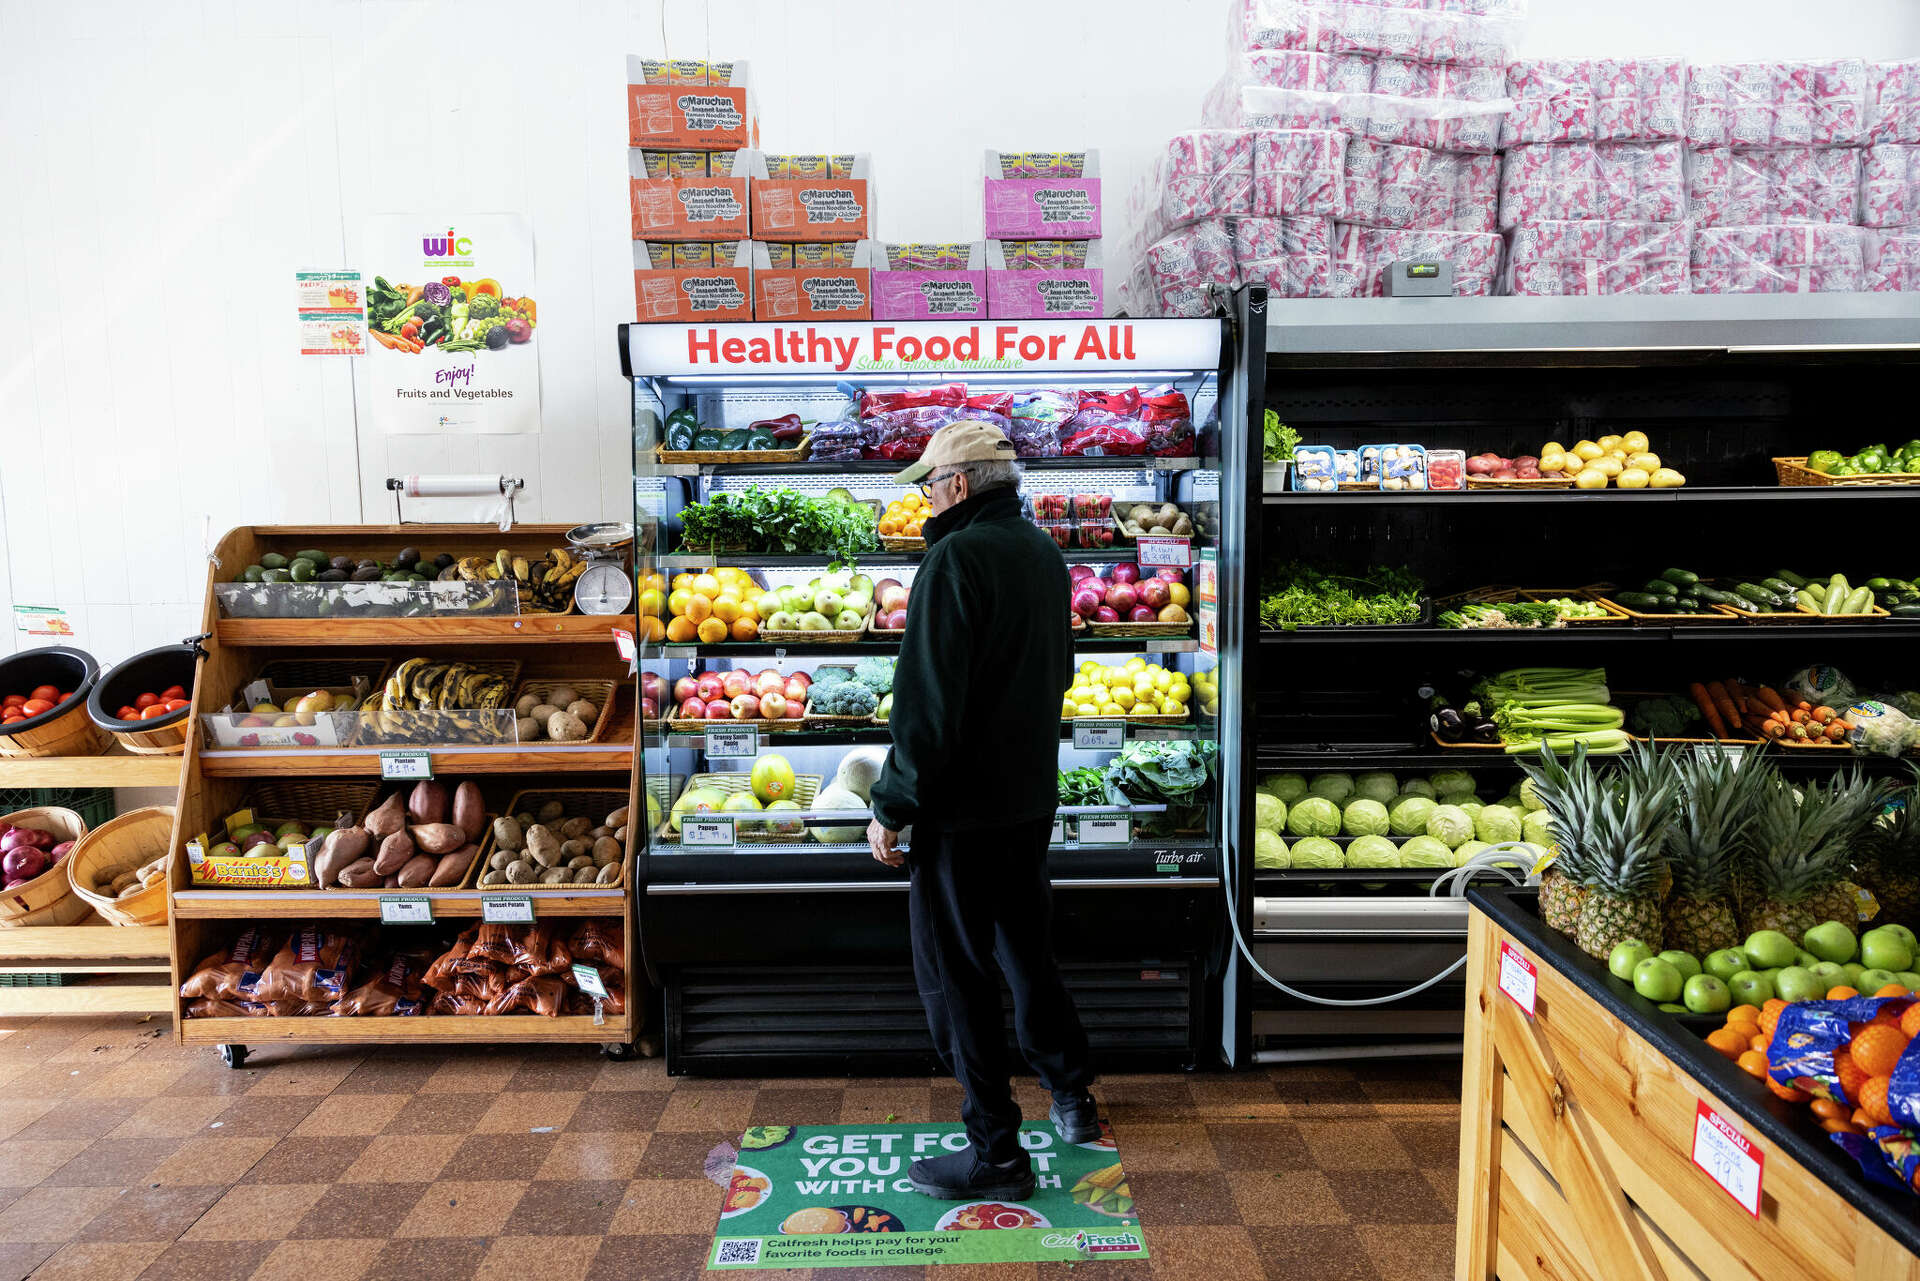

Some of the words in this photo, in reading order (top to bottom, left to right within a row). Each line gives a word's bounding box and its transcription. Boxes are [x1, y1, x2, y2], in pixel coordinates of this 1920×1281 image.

[688, 96, 732, 106] Maruchan
[688, 120, 702, 128] 24
[688, 187, 732, 196] Maruchan
[810, 189, 852, 198] Maruchan
[808, 212, 822, 221] 24
[692, 278, 735, 286] Maruchan
[813, 278, 855, 286] Maruchan
[929, 281, 971, 289] Maruchan
[1046, 280, 1088, 288] Maruchan
[692, 300, 706, 309] 24
[812, 300, 826, 309] 24
[929, 303, 943, 312] 24
[688, 327, 860, 371] Healthy
[873, 326, 980, 362] Food
[996, 326, 1066, 361] For
[1074, 325, 1136, 360] All
[856, 354, 894, 371] Saba
[961, 354, 1024, 370] Initiative
[435, 363, 475, 387] Enjoy!
[397, 388, 427, 398] Fruits
[430, 388, 451, 398] and
[454, 388, 513, 400] Vegetables
[1154, 850, 1184, 864] Turbo
[1186, 852, 1203, 863] air
[216, 864, 281, 877] Bernie's
[1709, 1111, 1750, 1152] SPECIAL!
[803, 1134, 902, 1155] GET
[914, 1130, 1053, 1152] FOD
[800, 1156, 900, 1178] YOU
[794, 1178, 885, 1196] WITH
[768, 1239, 828, 1248] Calfresh
[832, 1238, 872, 1247] helps
[876, 1238, 902, 1246] pay
[906, 1236, 926, 1244] for
[929, 1236, 961, 1245] your
[765, 1250, 822, 1259] favorite
[826, 1248, 867, 1257] foods
[887, 1246, 947, 1256] college.
